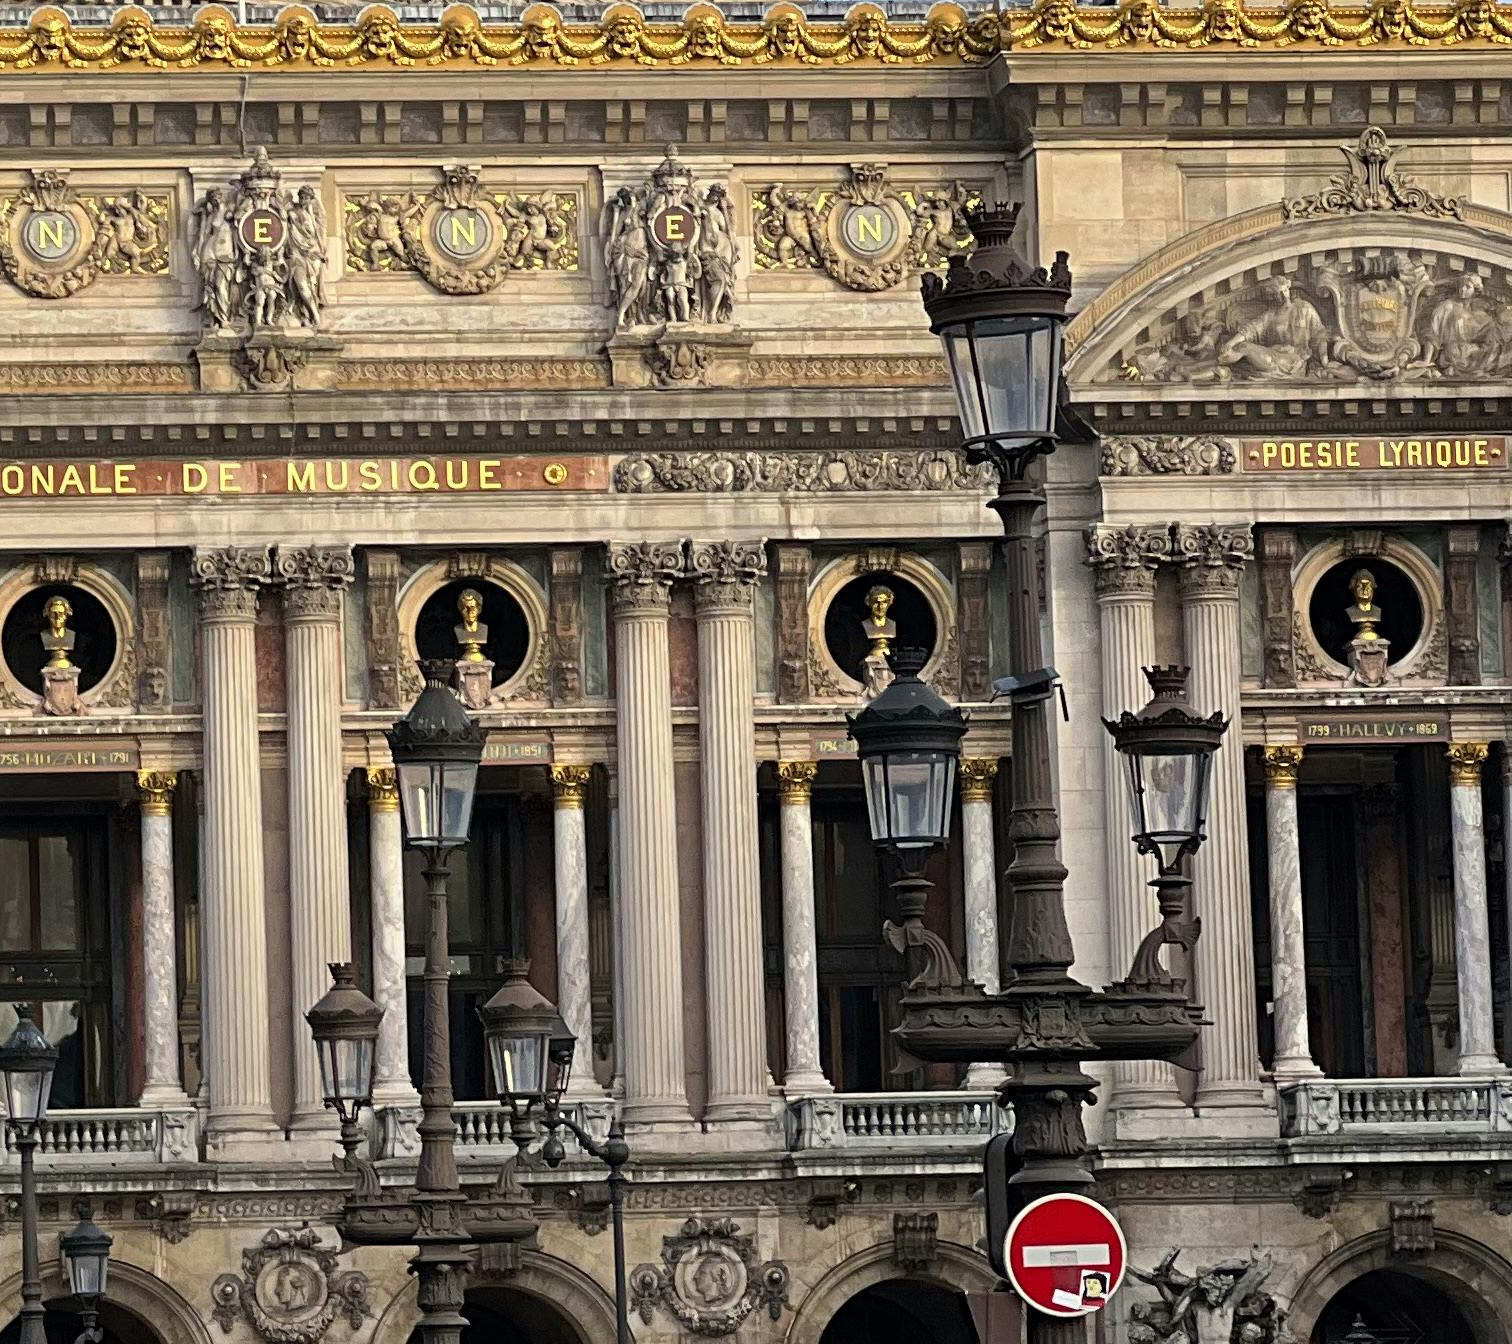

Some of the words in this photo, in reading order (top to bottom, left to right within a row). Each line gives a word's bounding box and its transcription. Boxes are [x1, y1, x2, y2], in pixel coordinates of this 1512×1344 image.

[39, 220, 65, 249] N
[254, 218, 272, 243] E
[451, 216, 478, 247] N
[666, 214, 684, 239] E
[857, 213, 883, 243] N
[1262, 441, 1361, 467] POESIE
[1379, 440, 1489, 467] LYRIQUE
[183, 462, 242, 494] DE
[287, 459, 502, 492] MUSIQUE
